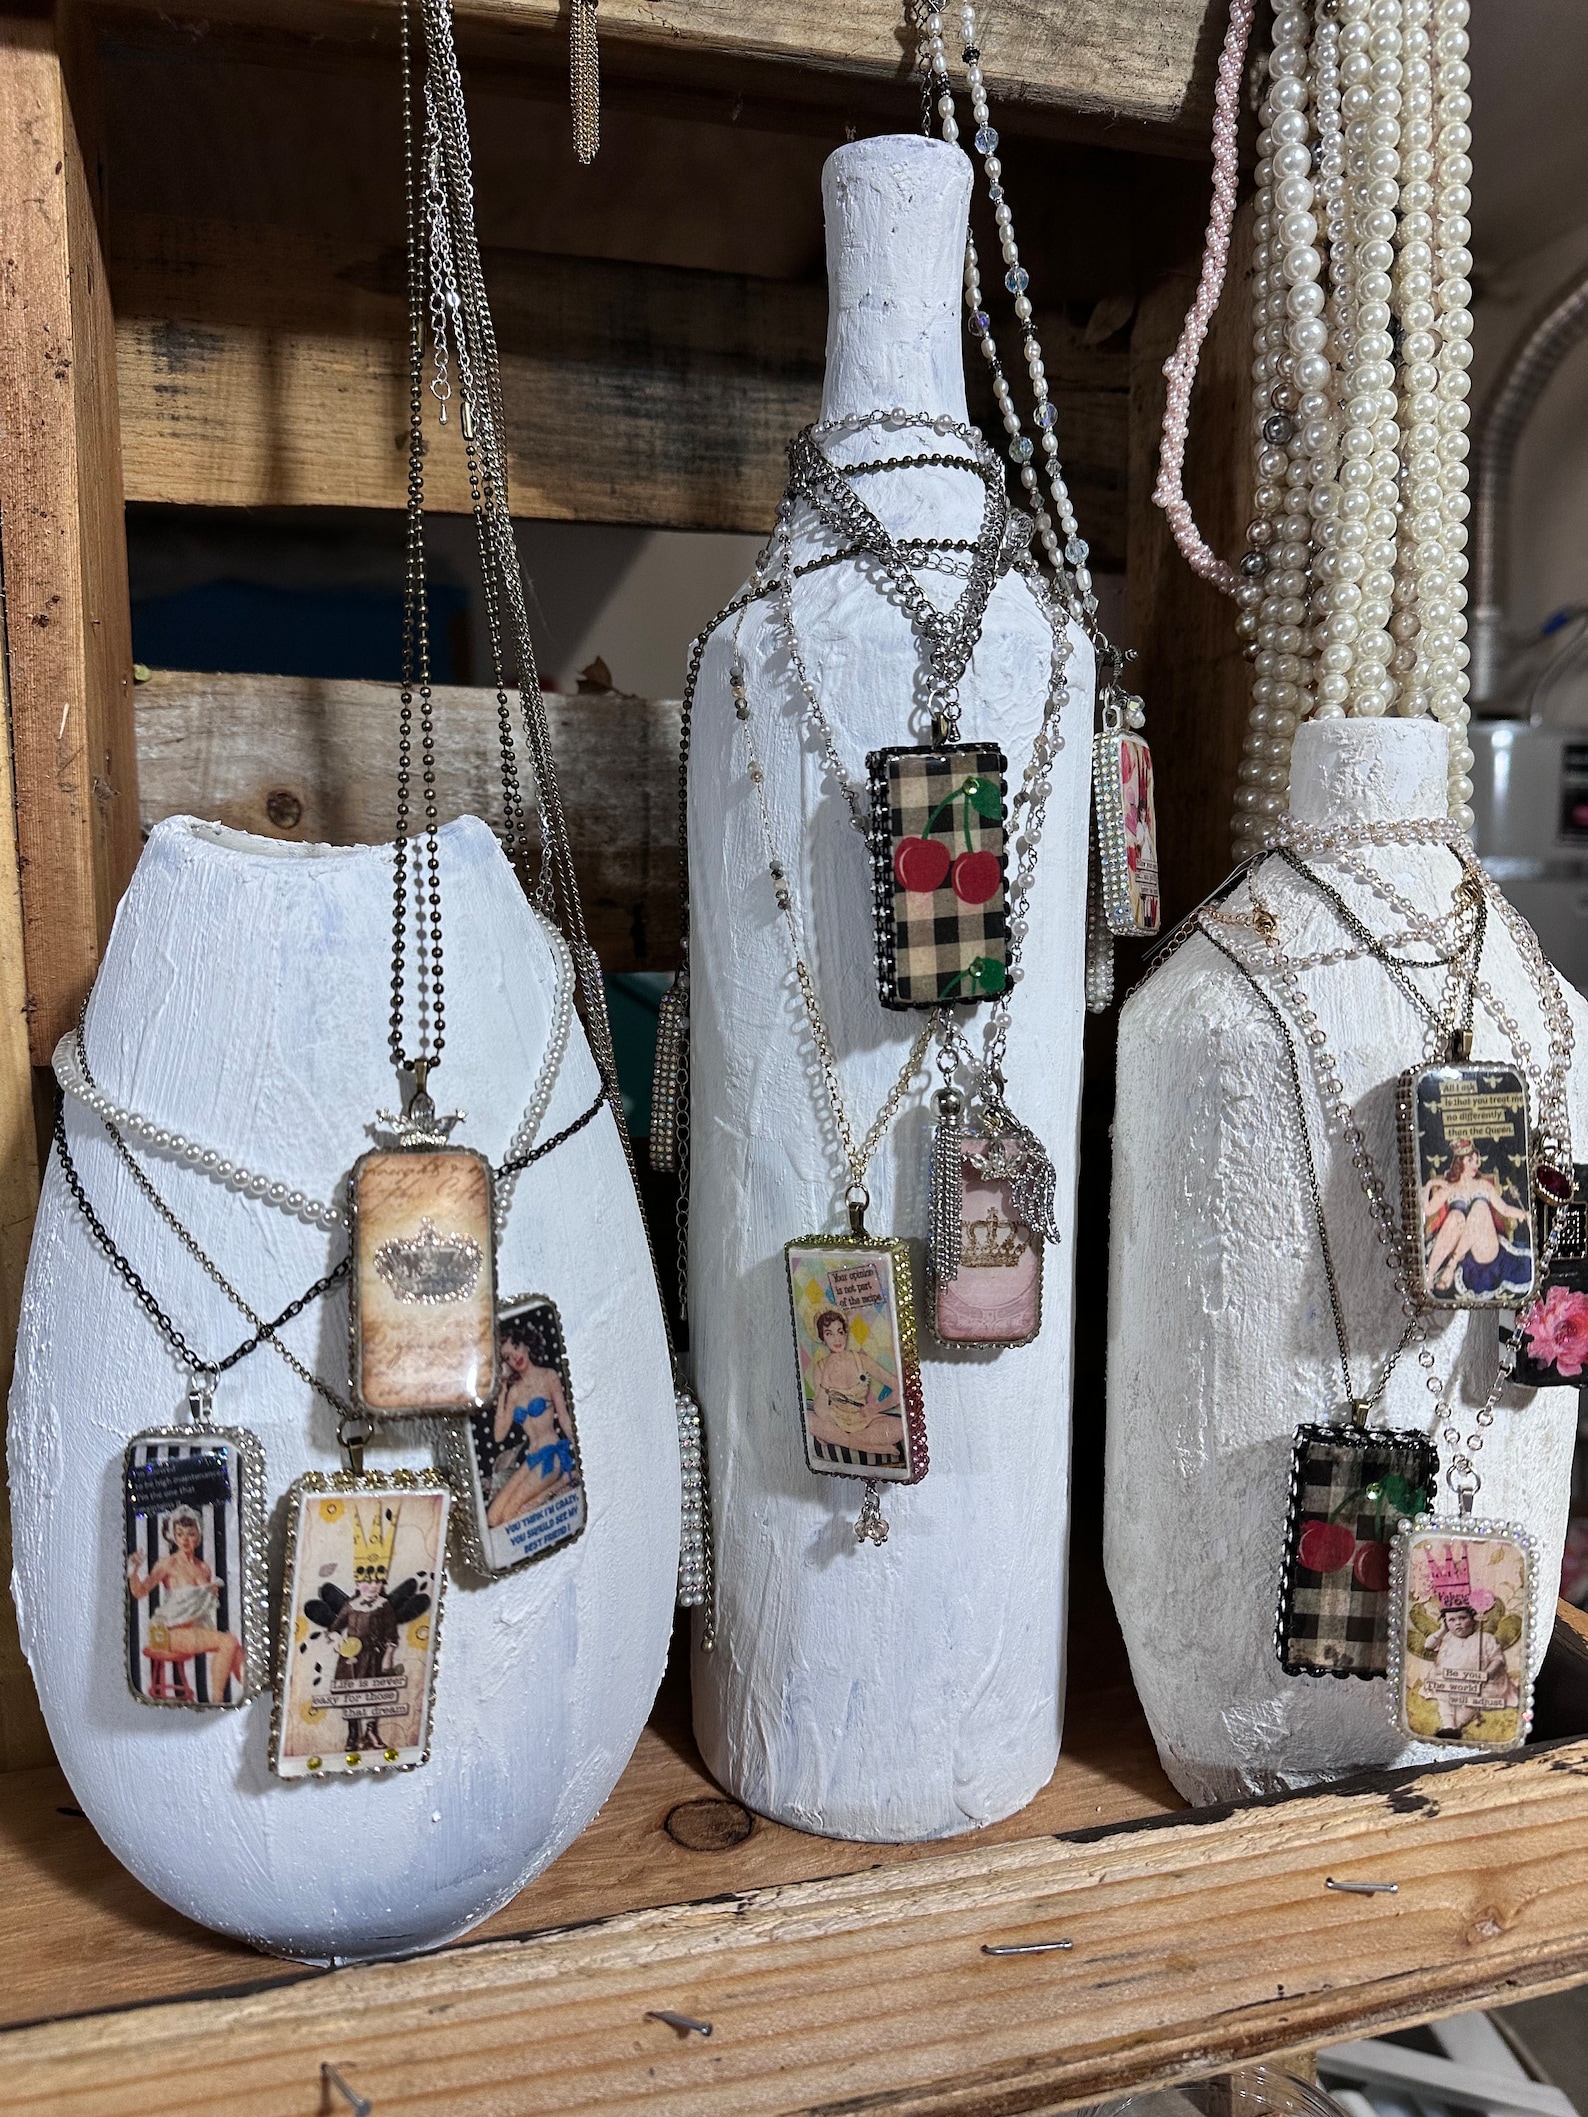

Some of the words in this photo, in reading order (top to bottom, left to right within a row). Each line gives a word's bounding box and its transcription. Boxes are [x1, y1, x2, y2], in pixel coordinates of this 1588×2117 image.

[1444, 1084, 1454, 1092] All
[1461, 1083, 1475, 1091] ask
[1453, 1098, 1471, 1106] that
[1472, 1097, 1488, 1107] you
[1490, 1095, 1510, 1104] treat
[1446, 1113, 1457, 1121] no
[1460, 1110, 1502, 1122] differently
[1469, 1127, 1484, 1136] the
[832, 1273, 847, 1283] Your
[849, 1269, 874, 1280] opinion
[835, 1287, 843, 1295] is
[844, 1285, 856, 1294] not
[857, 1281, 872, 1293] part
[839, 1297, 847, 1307] of
[848, 1296, 861, 1306] the
[505, 1521, 521, 1535] YOU
[522, 1509, 544, 1527] THINK
[510, 1532, 526, 1546] YOU
[526, 1518, 555, 1539] SHOULD
[555, 1511, 568, 1525] SEE
[567, 1505, 578, 1518] MY
[524, 1539, 543, 1554] BEST
[1446, 1669, 1458, 1677] Be
[332, 1679, 355, 1689] Life
[359, 1678, 368, 1687] is
[372, 1677, 405, 1687] never
[1426, 1680, 1445, 1689] The
[1450, 1683, 1478, 1692] world
[313, 1696, 339, 1706] easy
[345, 1693, 362, 1703] for
[365, 1691, 395, 1701] those
[1451, 1695, 1468, 1704] will
[1472, 1697, 1503, 1707] adjust
[344, 1708, 367, 1717] that
[371, 1705, 406, 1716] dream
